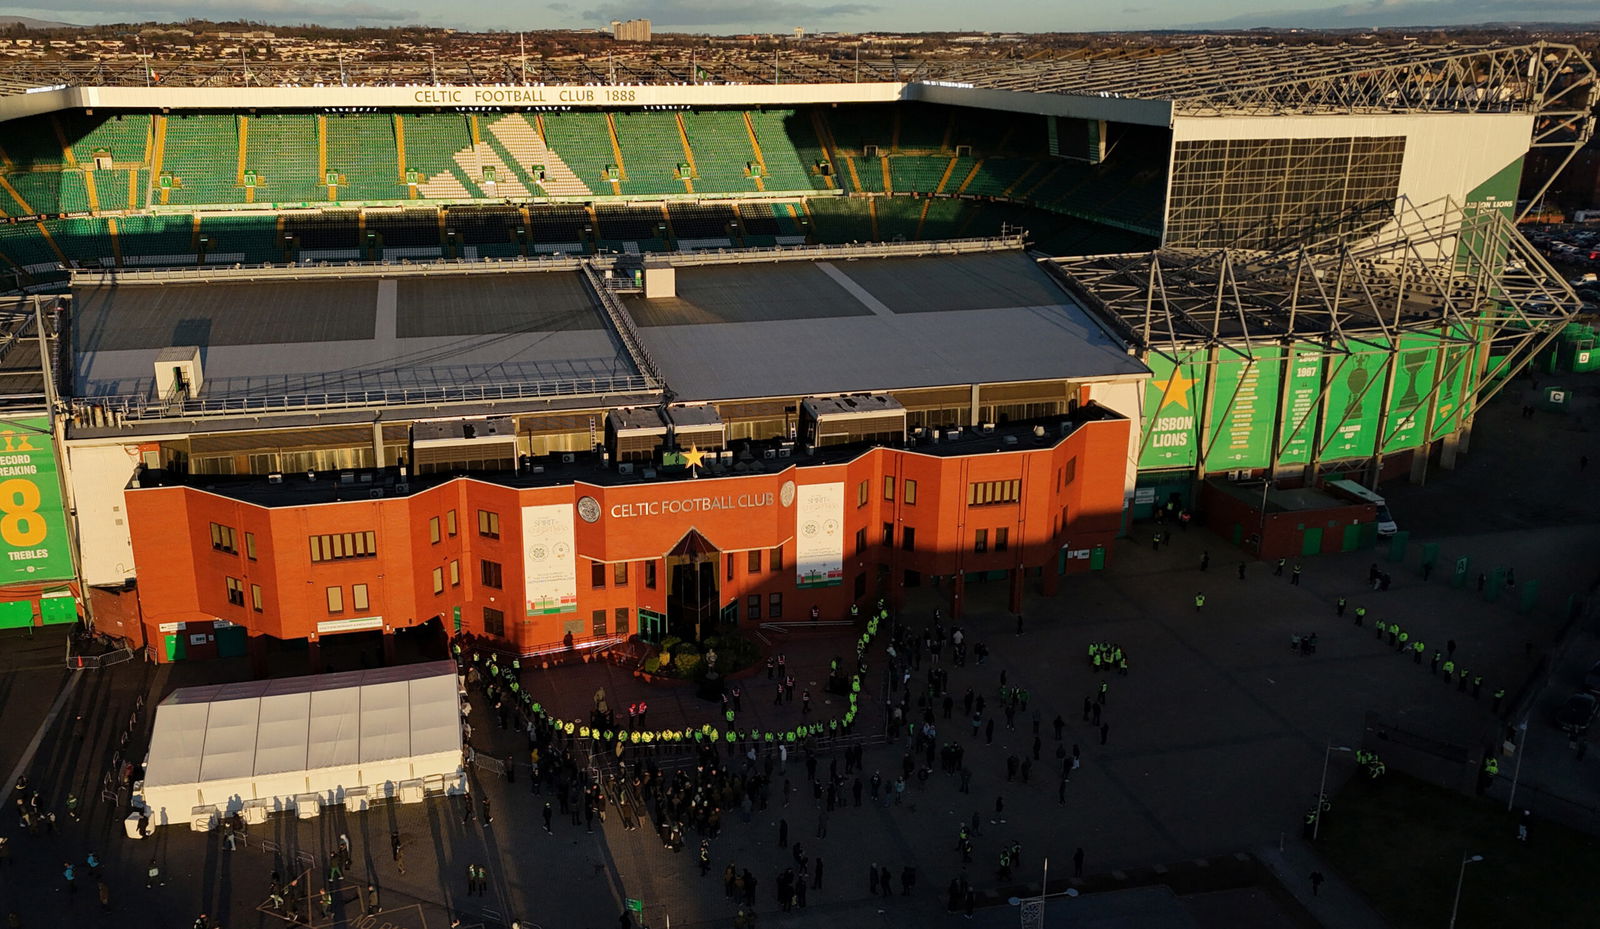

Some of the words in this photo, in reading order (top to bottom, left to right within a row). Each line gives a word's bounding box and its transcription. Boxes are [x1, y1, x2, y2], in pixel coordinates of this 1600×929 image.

[414, 90, 461, 102] CELTIC
[475, 90, 546, 102] FOOTBALL
[559, 90, 594, 101] CLUB
[606, 90, 636, 101] 1888
[1296, 367, 1317, 378] 1967
[1151, 415, 1193, 432] LISBON
[1153, 432, 1188, 448] LIONS
[0, 454, 31, 466] ECORD
[0, 464, 37, 477] REAKING
[611, 501, 659, 518] CELTIC
[662, 496, 736, 514] FOOTBALL
[737, 492, 775, 508] CLUB
[0, 478, 47, 547] 8
[8, 549, 48, 561] TREBLES
